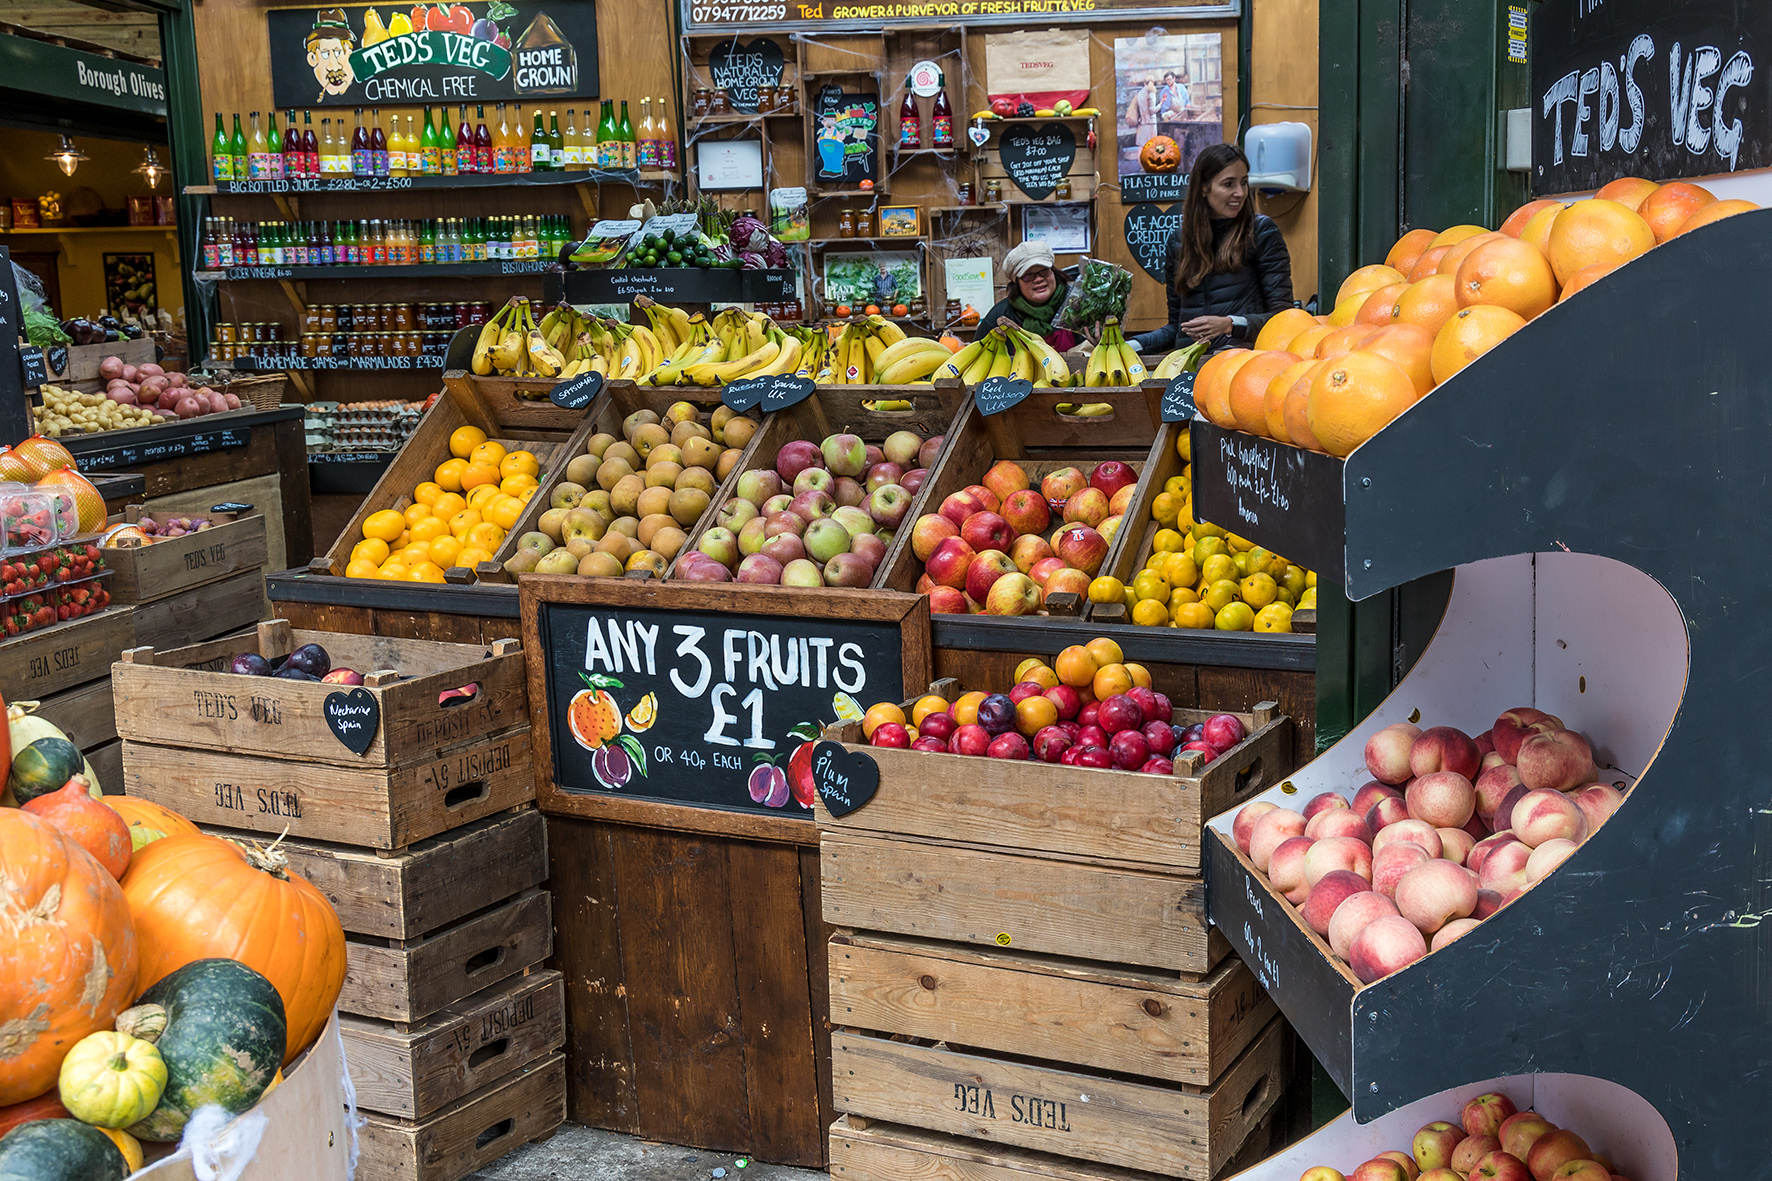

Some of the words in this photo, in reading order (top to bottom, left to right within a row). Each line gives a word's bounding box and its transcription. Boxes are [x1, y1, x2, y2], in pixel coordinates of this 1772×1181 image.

[692, 4, 787, 22] 07947712259
[797, 2, 824, 19] Ted
[961, 2, 978, 14] OF
[980, 1, 1021, 14] FRESH
[362, 31, 434, 74] TED'S
[441, 32, 491, 68] VEG
[519, 48, 563, 67] HOME
[724, 53, 763, 68] TED'S
[77, 60, 128, 97] Borough
[130, 72, 165, 102] Olives
[517, 65, 572, 88] GROWN
[714, 65, 783, 79] NATURALLY
[717, 77, 745, 88] HOME
[745, 76, 779, 88] GROWN
[365, 77, 439, 101] CHEMICAL
[442, 75, 478, 97] FREE
[734, 88, 758, 100] VEG
[1543, 33, 1655, 167] TED'S
[1669, 41, 1755, 173] VEG
[1009, 137, 1030, 146] TED'S
[1032, 136, 1044, 145] VEG
[1046, 136, 1061, 146] BAG
[229, 180, 247, 193] BIG
[248, 179, 289, 193] BOTTLED
[292, 178, 321, 192] JUICE
[1124, 175, 1169, 189] PLASTIC
[1146, 188, 1158, 199] 10
[1160, 189, 1180, 198] PENCE
[1128, 215, 1147, 231] WE
[1127, 229, 1168, 245] CREDIT
[230, 267, 250, 279] CIDER
[250, 267, 277, 279] VINEGAR
[828, 284, 855, 294] PLANT
[312, 356, 338, 369] JAMS
[349, 356, 411, 369] MARMALADES
[767, 389, 787, 400] UK
[982, 382, 1003, 393] Red
[985, 400, 1008, 411] UK
[184, 549, 207, 571] TED'S
[210, 543, 226, 563] VEG
[30, 656, 50, 679] VEG
[54, 646, 81, 673] TED'S
[585, 616, 659, 675] ANY
[669, 624, 712, 698] 3
[723, 628, 867, 693] FRUITS
[194, 690, 239, 721] TED'S
[251, 696, 283, 725] VEG
[329, 703, 371, 716] Nectarine
[704, 683, 777, 749] £1
[338, 718, 362, 734] Spain
[417, 711, 470, 750] DEPOSIT
[457, 744, 511, 784] DEPOSIT
[654, 746, 673, 764] OR
[680, 748, 706, 770] 40p
[713, 752, 742, 771] EACH
[215, 782, 245, 811] VEG
[259, 789, 302, 819] TED'S
[480, 995, 535, 1041] DEPOSIT
[954, 1083, 997, 1119] VEG
[1012, 1095, 1071, 1132] TED'S
